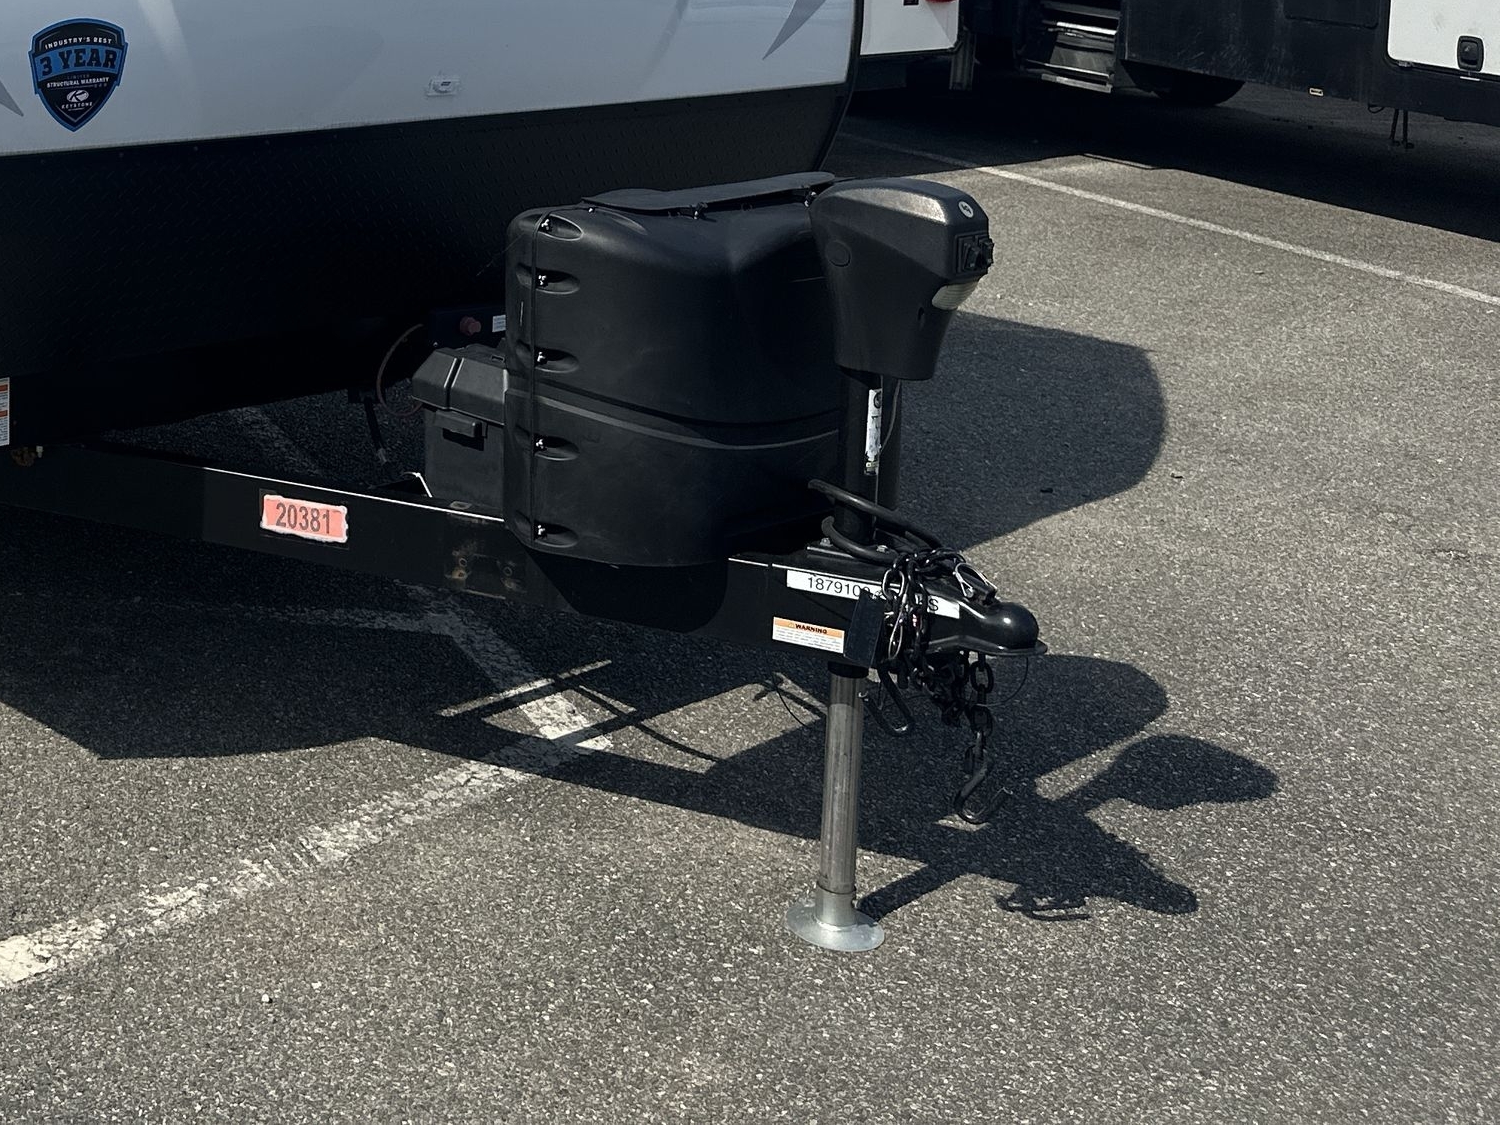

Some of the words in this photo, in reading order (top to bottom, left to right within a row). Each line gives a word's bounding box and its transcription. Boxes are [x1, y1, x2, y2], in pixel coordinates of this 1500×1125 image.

[45, 37, 90, 50] INDUSTRY'S
[40, 56, 53, 76] 3
[58, 48, 116, 70] YEAR
[275, 502, 330, 534] 20381
[795, 623, 828, 635] WARNING
